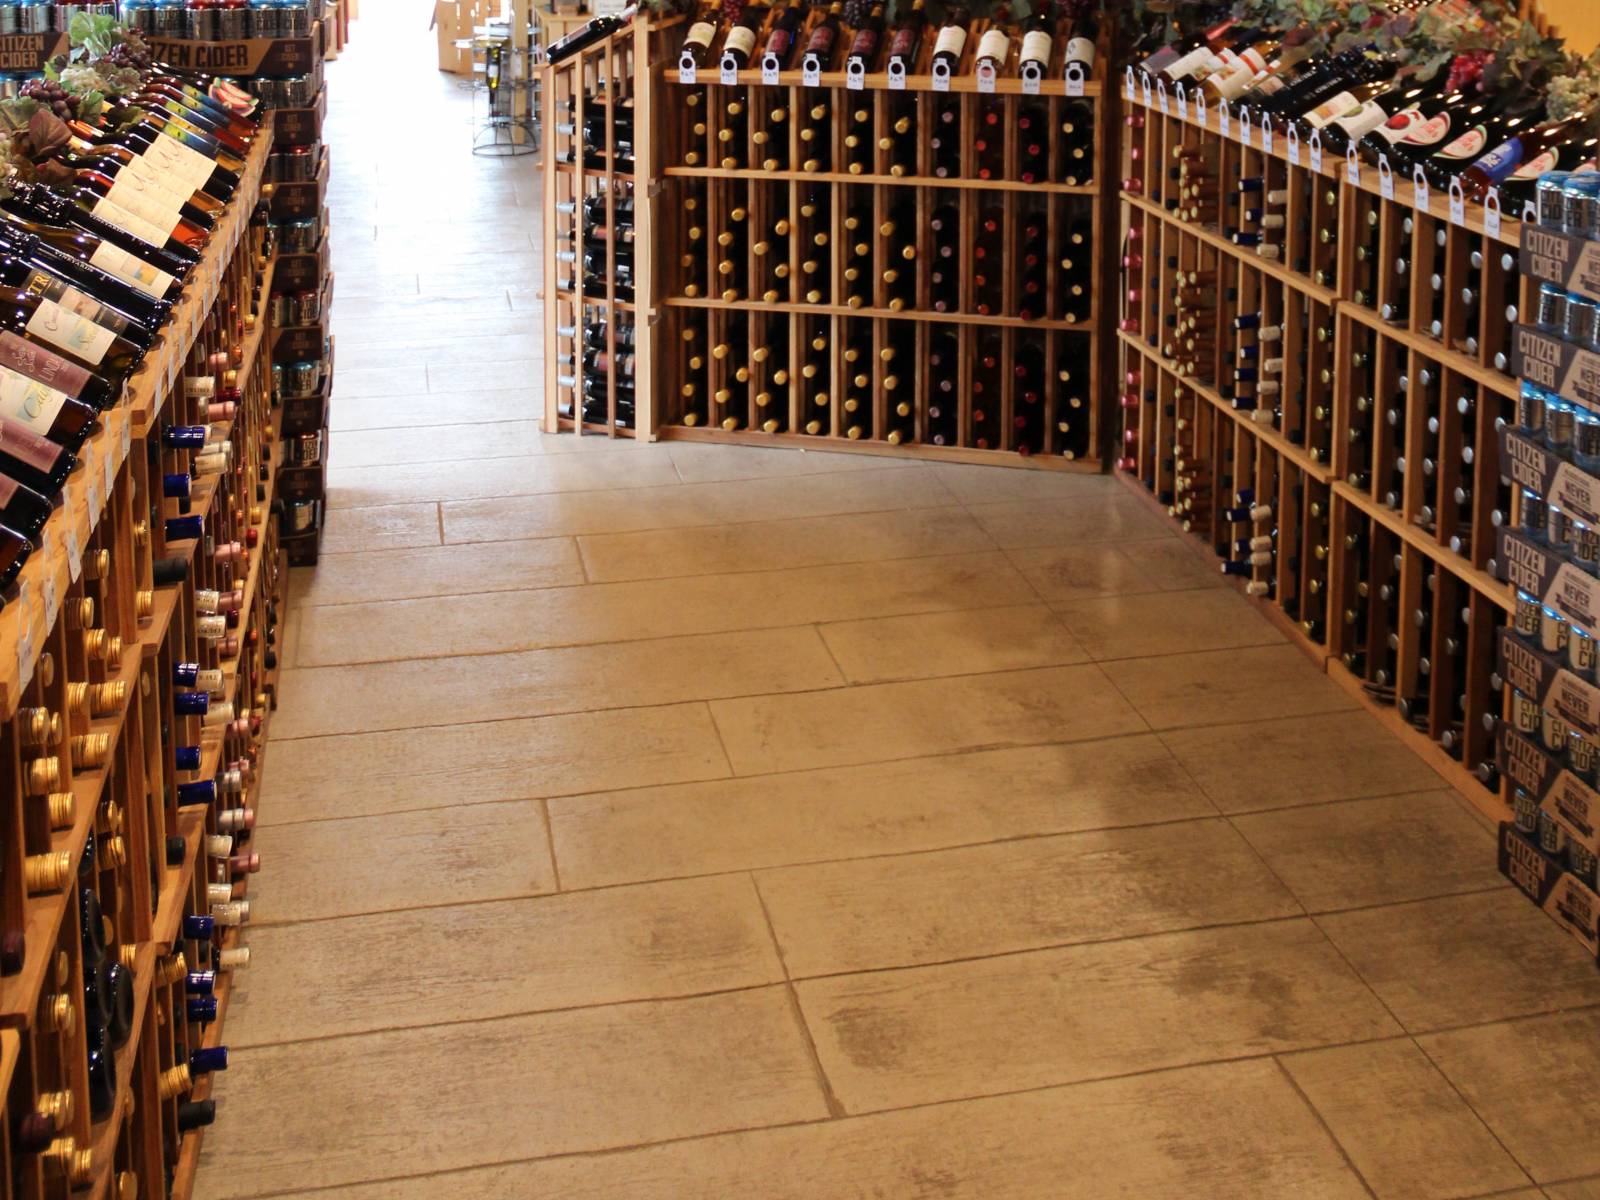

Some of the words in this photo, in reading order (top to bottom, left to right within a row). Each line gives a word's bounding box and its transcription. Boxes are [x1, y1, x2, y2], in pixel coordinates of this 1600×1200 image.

[0, 35, 44, 51] ITIZEN
[196, 44, 248, 67] CIDER
[54, 249, 95, 273] VINEYARDS
[1526, 229, 1569, 262] CITIZEN
[1531, 254, 1562, 283] CIDER
[1519, 331, 1562, 367] CITIZEN
[1523, 355, 1555, 388] CIDER
[1506, 432, 1546, 476] CITIZEN
[1512, 458, 1542, 493] CIDER
[1565, 480, 1592, 503] NEVER
[1503, 534, 1546, 577] CITIZEN
[1509, 560, 1540, 596] CIDER
[1564, 581, 1590, 608] NEVER
[1503, 636, 1543, 682] CITIZEN
[1504, 729, 1547, 779] CITIZEN
